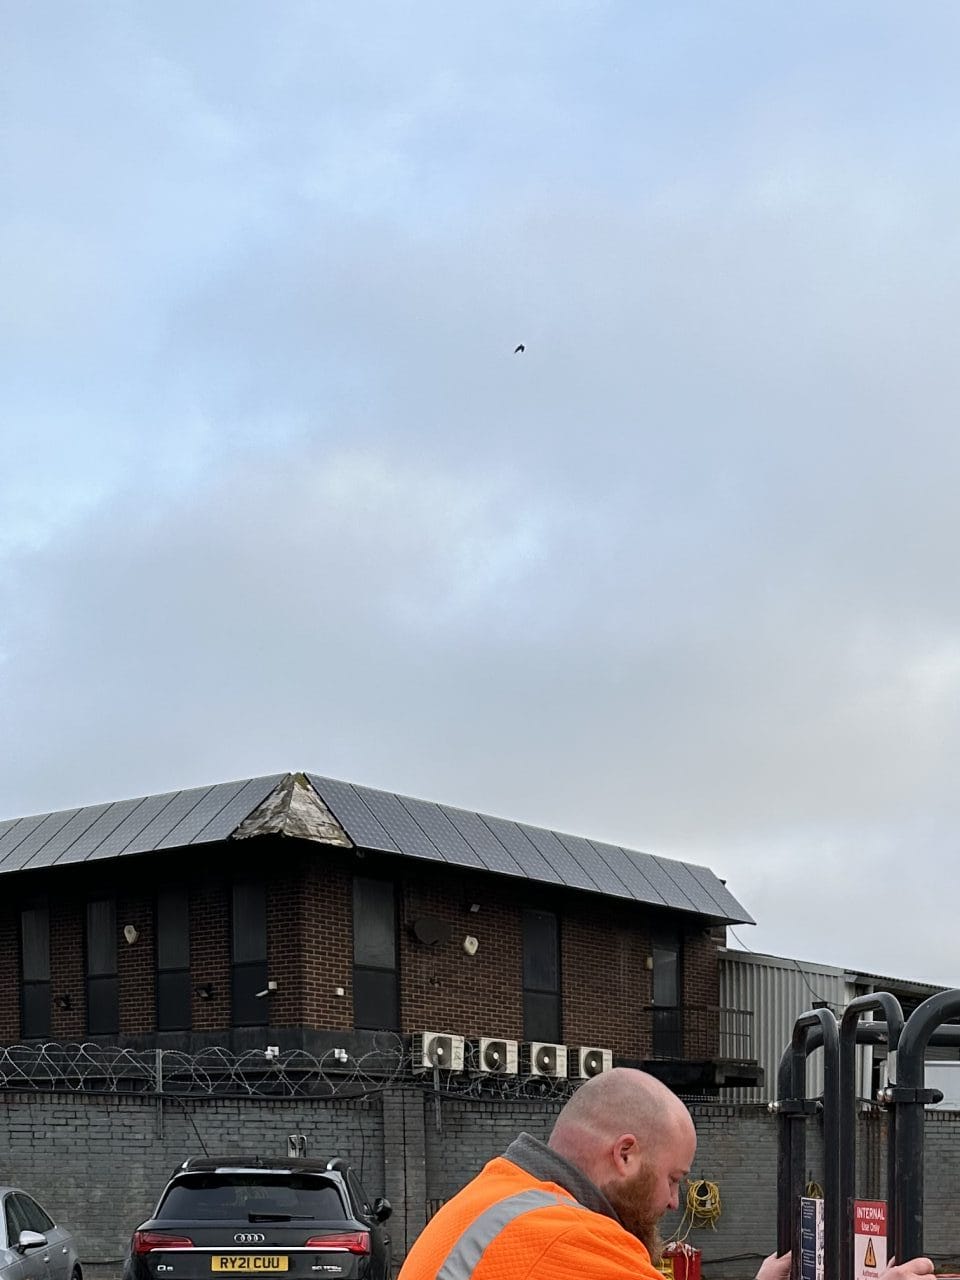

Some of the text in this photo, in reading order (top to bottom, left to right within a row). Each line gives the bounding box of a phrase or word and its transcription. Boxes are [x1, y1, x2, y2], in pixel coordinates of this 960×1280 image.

[856, 1206, 885, 1220] INTERNAL
[861, 1221, 880, 1234] Use Only
[219, 1256, 280, 1270] RY21 CUU
